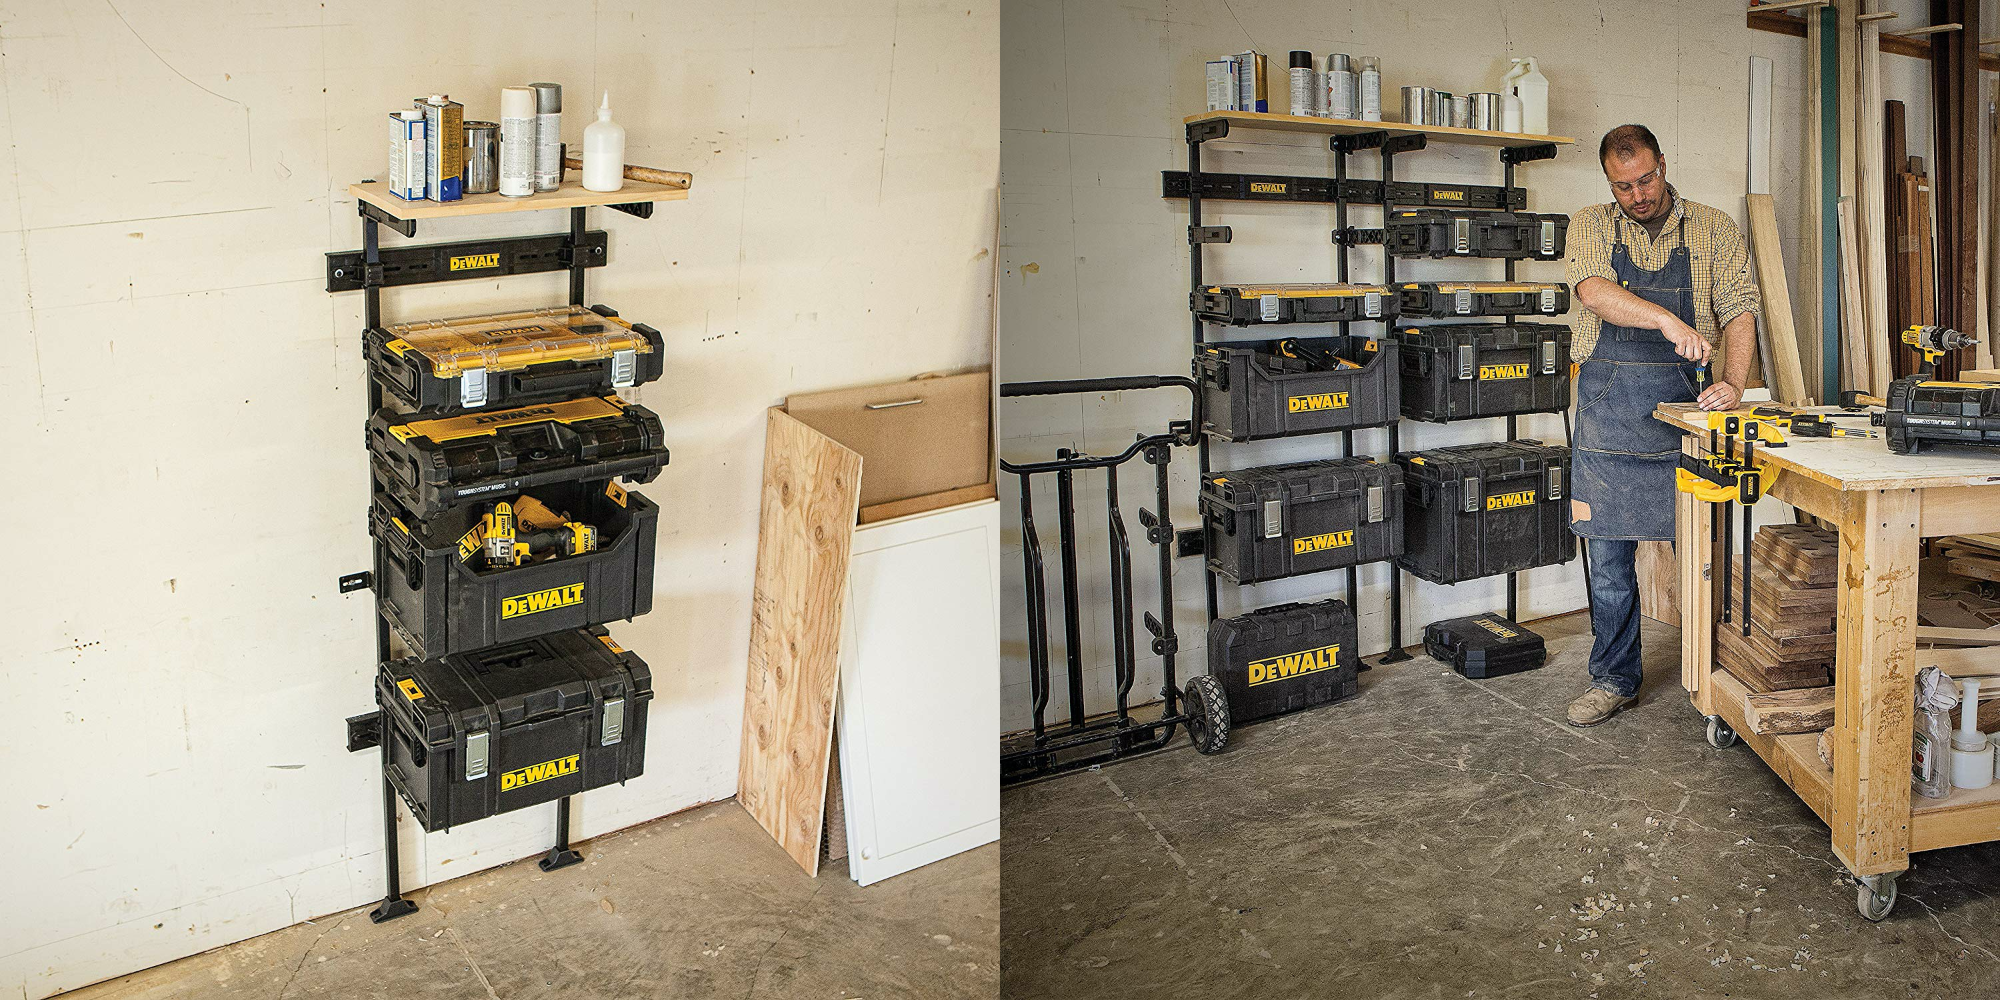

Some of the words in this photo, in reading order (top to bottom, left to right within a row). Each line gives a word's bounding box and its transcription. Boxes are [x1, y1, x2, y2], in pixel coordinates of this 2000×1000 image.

[1251, 182, 1286, 194] DEWALT
[1434, 190, 1463, 201] DEWALT
[450, 253, 500, 271] DEWALT
[1480, 364, 1529, 380] DEWALT
[1288, 392, 1349, 413] DEWALT
[1487, 490, 1535, 511] DEWALT
[1294, 530, 1353, 555] DEWALT
[502, 583, 584, 619] DEWALT
[1248, 644, 1340, 686] DEWALT
[501, 754, 580, 792] DEWALT
